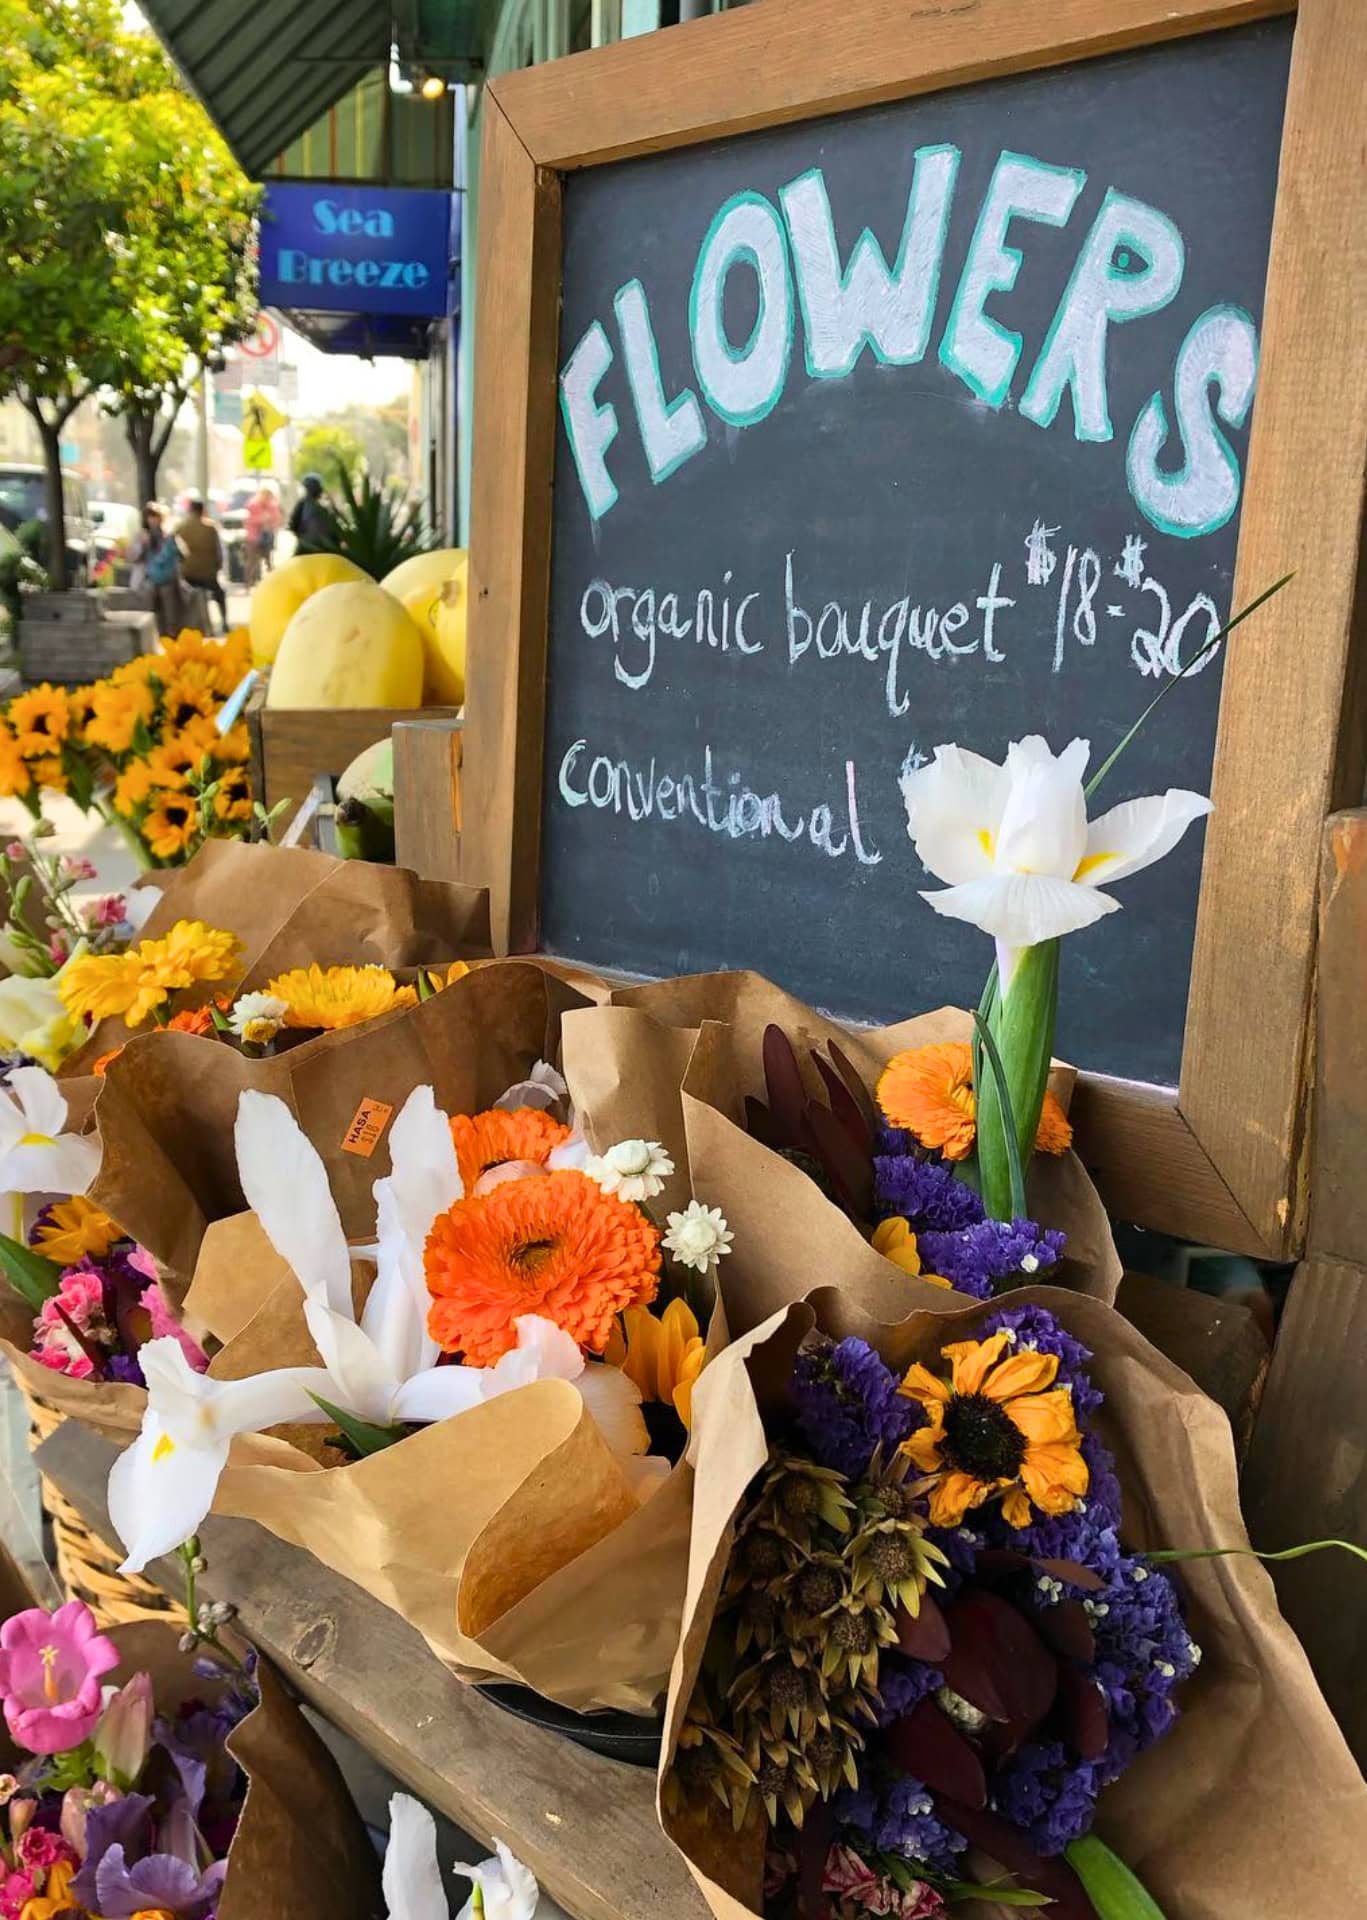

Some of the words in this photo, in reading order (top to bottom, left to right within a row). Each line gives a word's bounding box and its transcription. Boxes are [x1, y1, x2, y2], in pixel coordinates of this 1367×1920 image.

[312, 199, 395, 238] Sea
[277, 248, 430, 288] Breeze
[559, 143, 1261, 539] FLOWERS
[580, 571, 763, 690] organic
[785, 549, 1016, 717] bouquet
[348, 1110, 371, 1144] HASA
